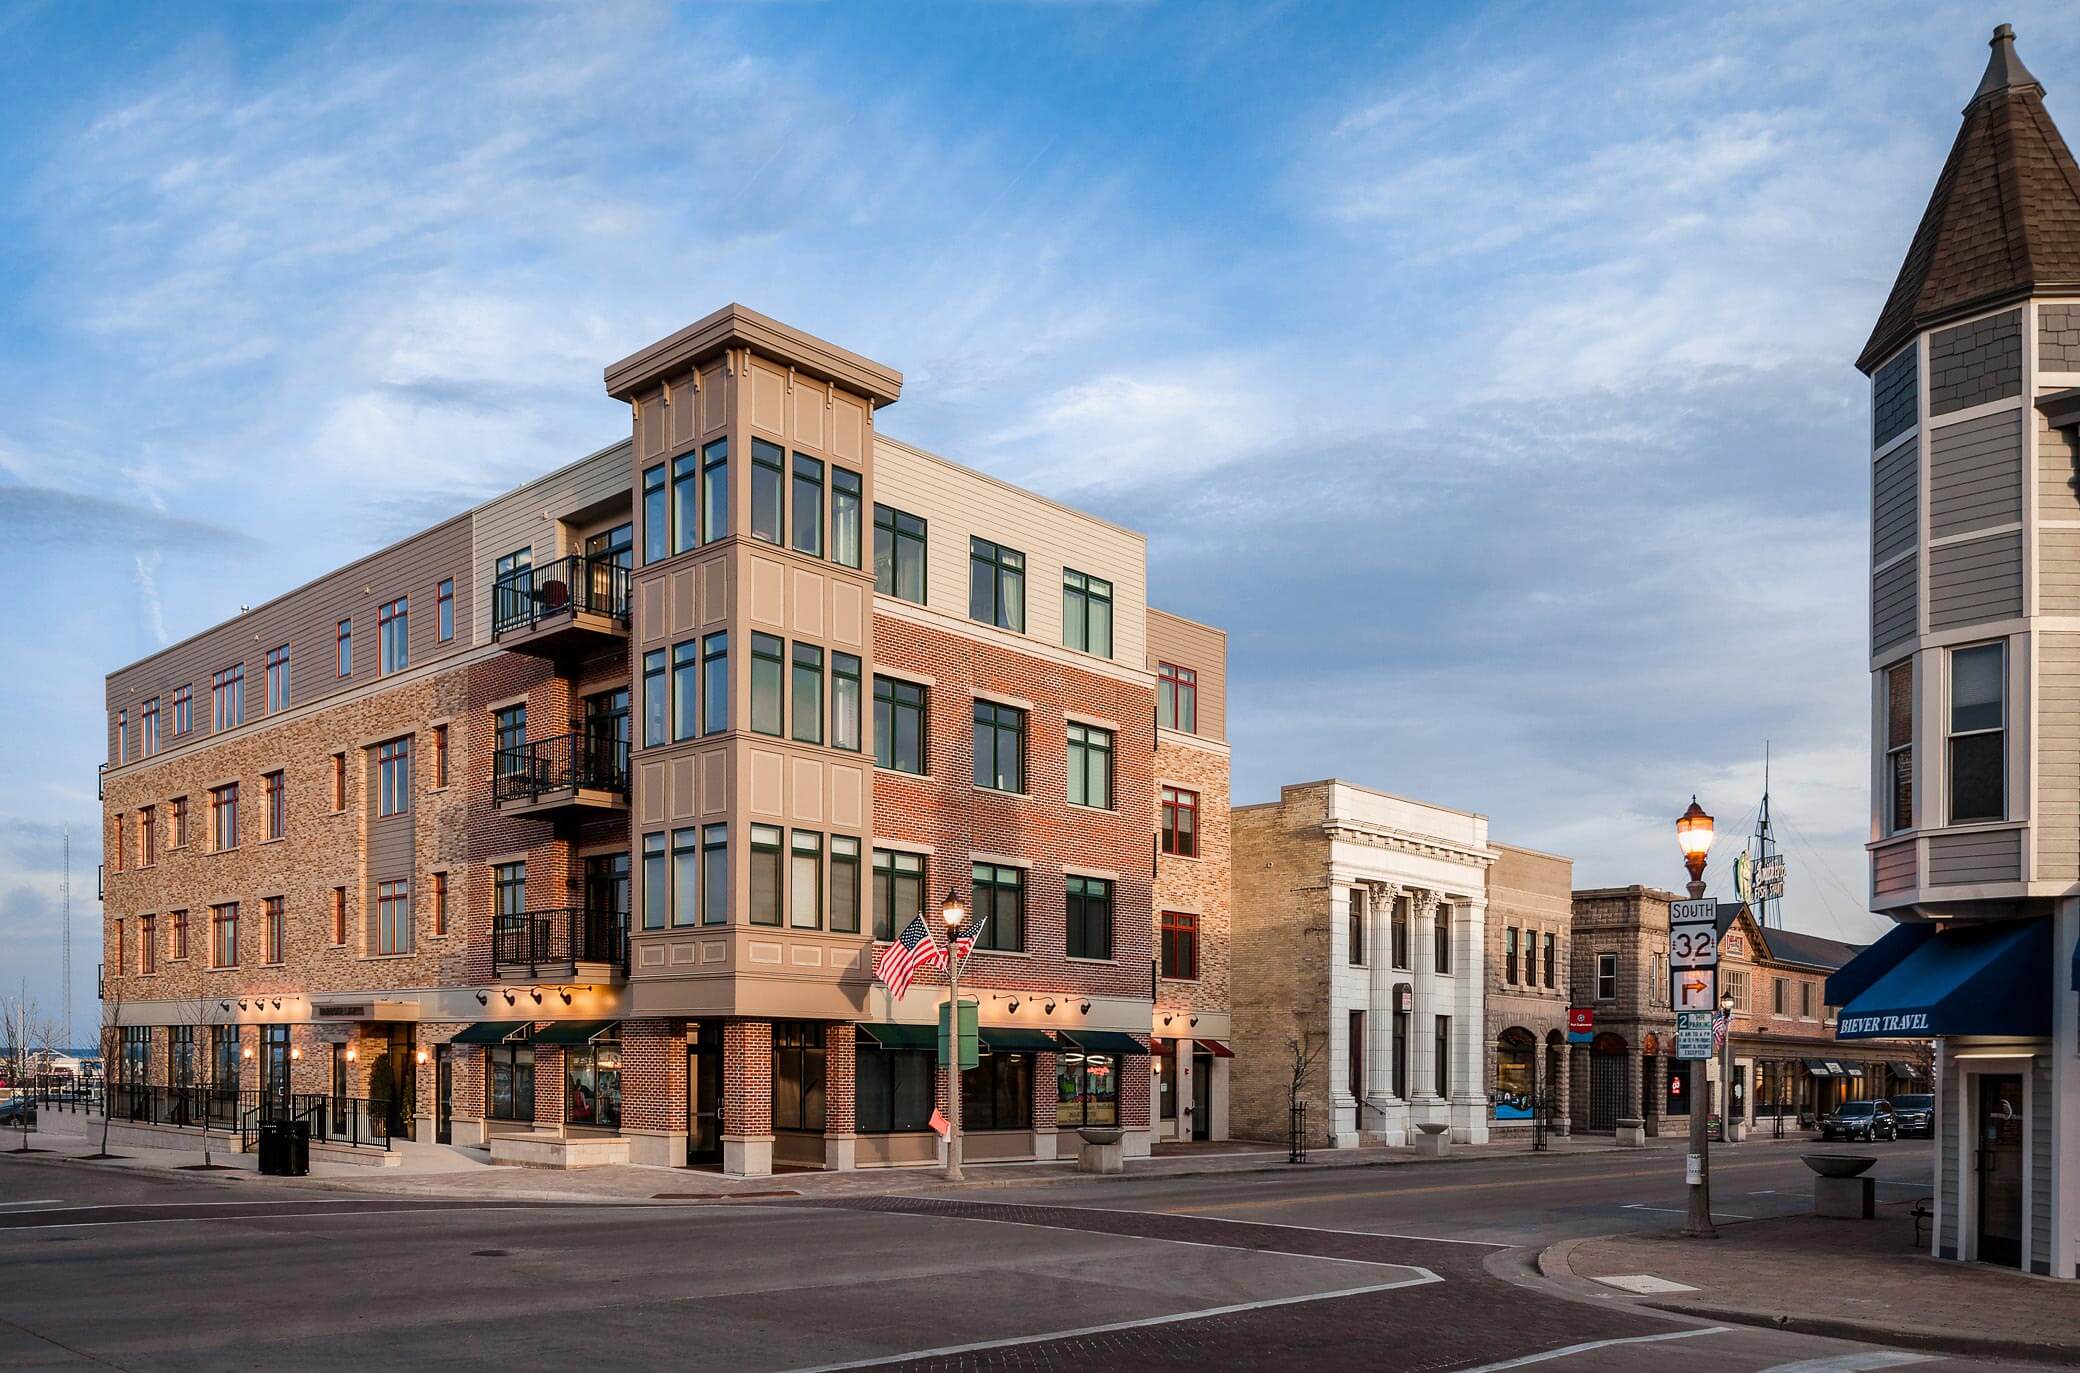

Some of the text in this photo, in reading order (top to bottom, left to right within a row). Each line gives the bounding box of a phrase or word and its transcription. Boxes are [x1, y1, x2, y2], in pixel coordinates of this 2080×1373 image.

[1672, 903, 1713, 918] SOUTH
[1676, 932, 1711, 958] 32
[1679, 1015, 1688, 1029] 2
[1840, 1013, 1928, 1034] BIEVER TRAVEL
